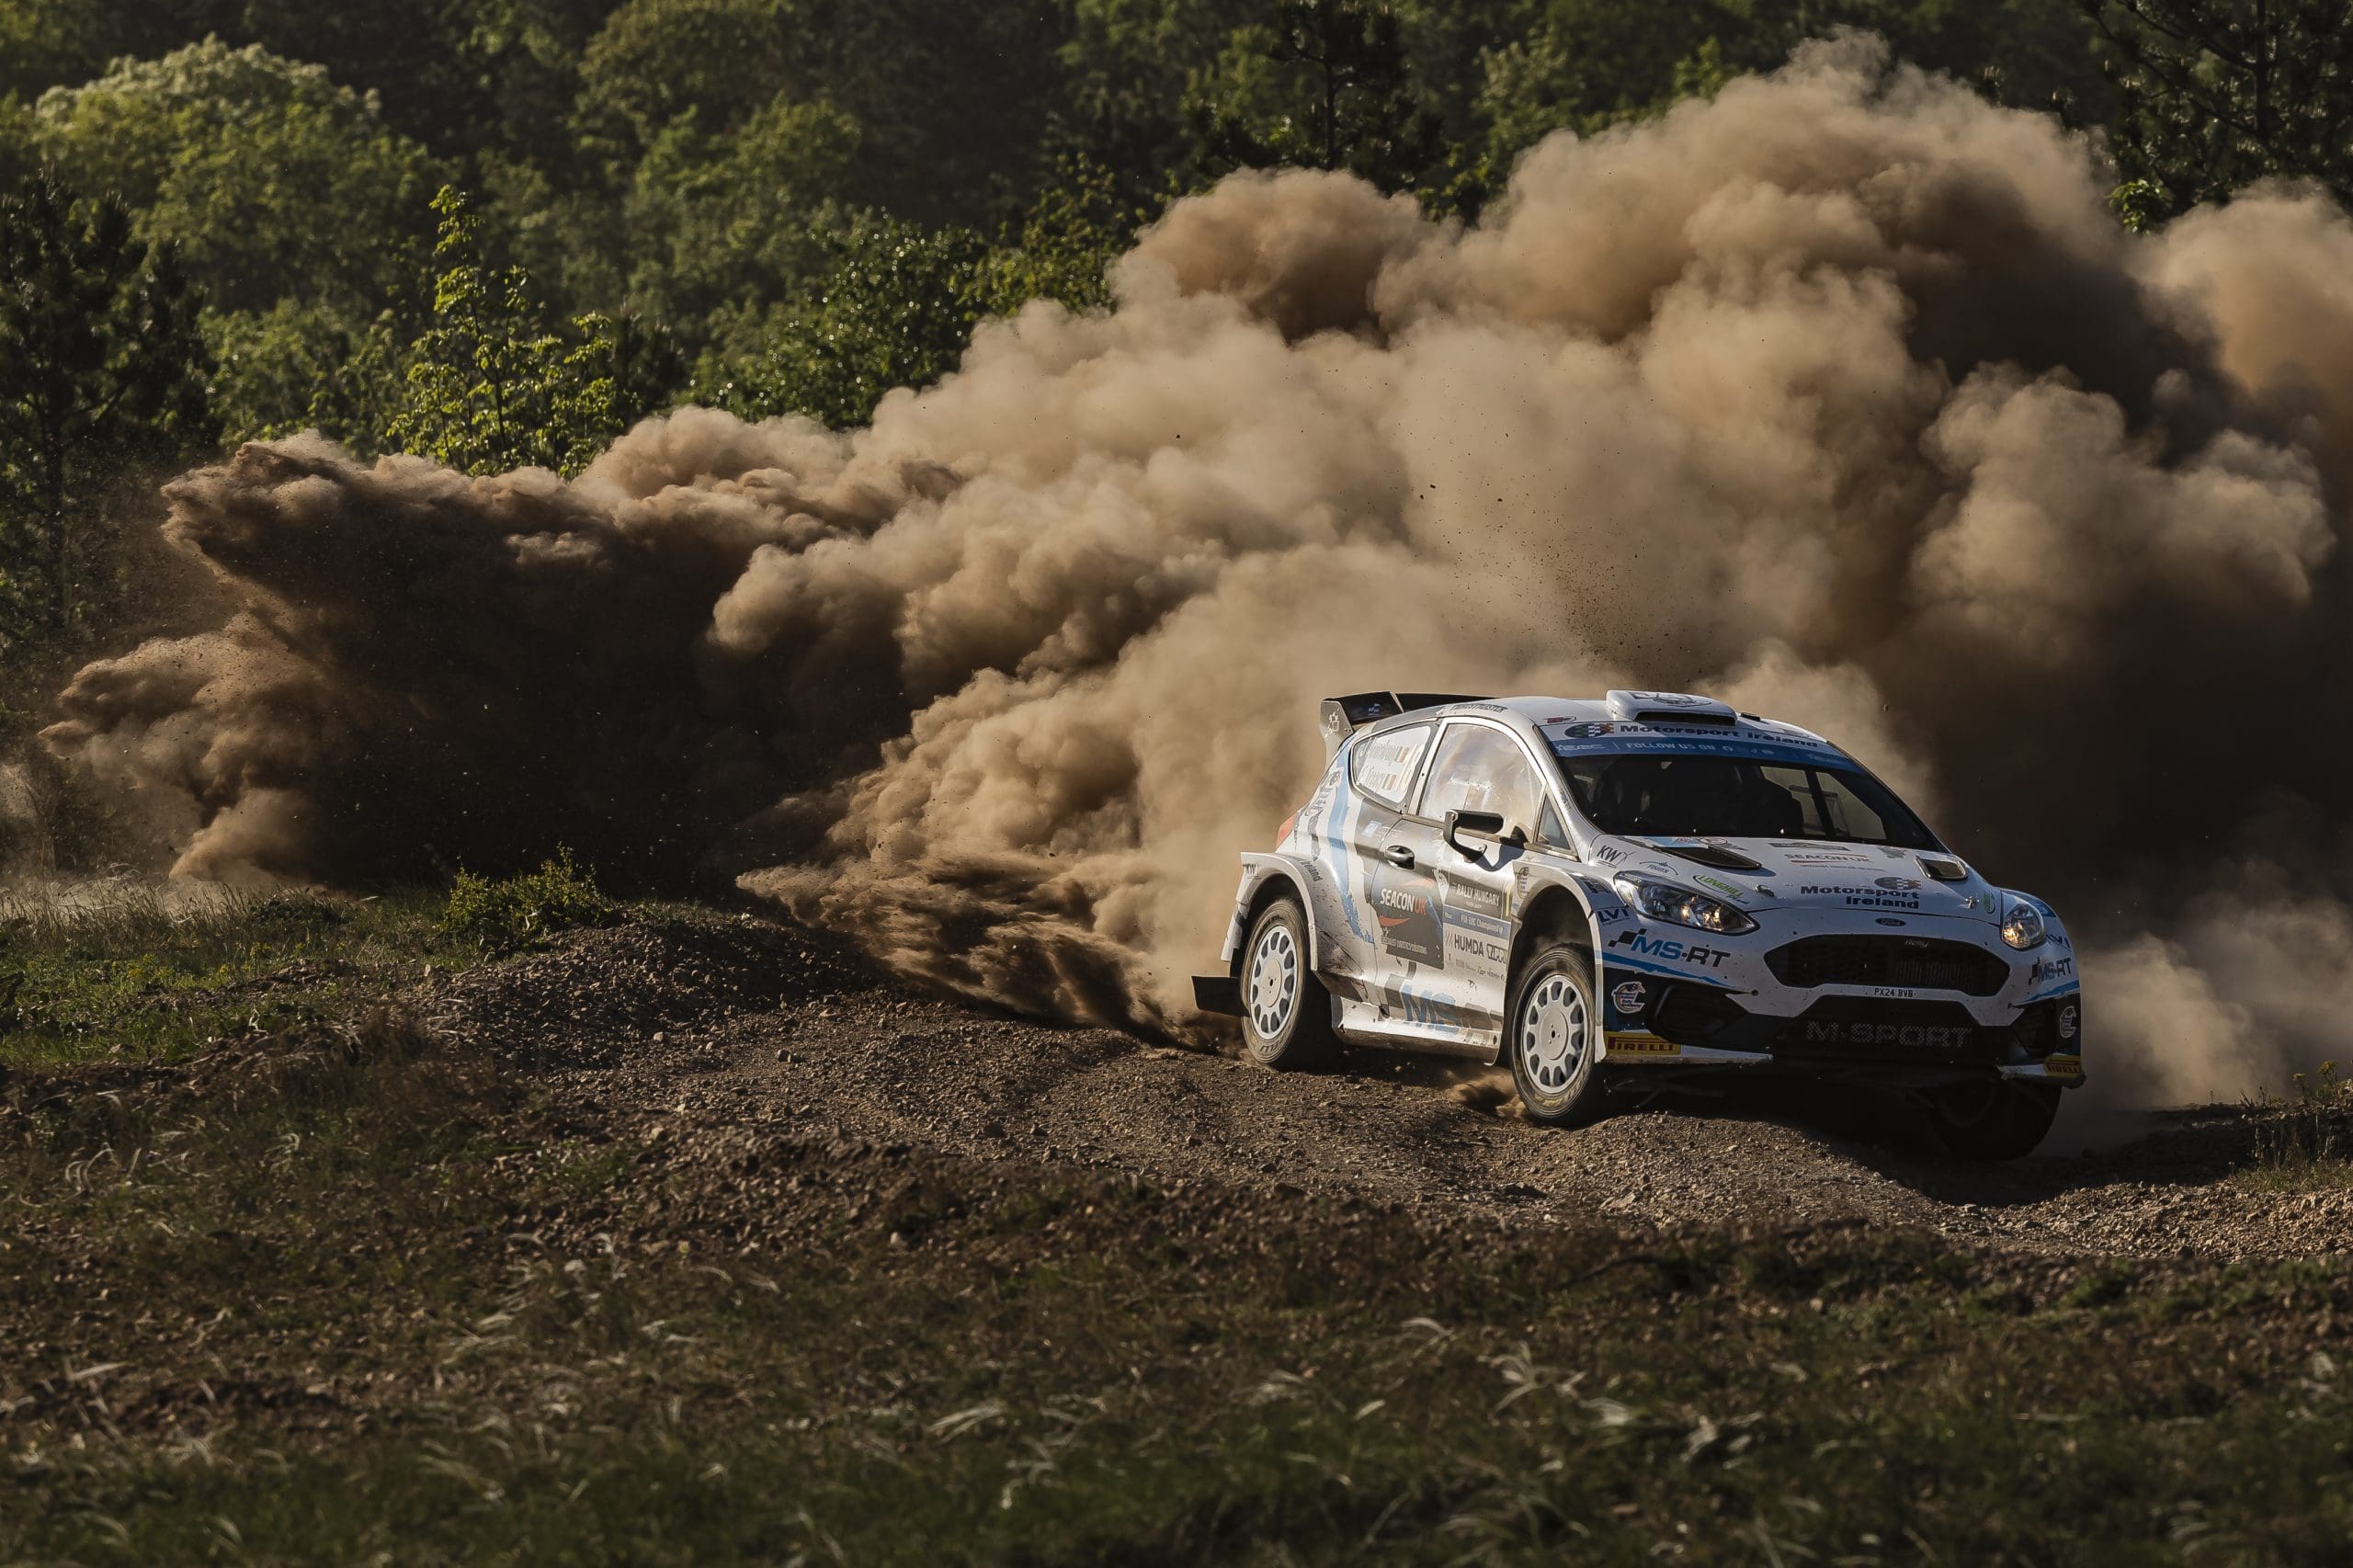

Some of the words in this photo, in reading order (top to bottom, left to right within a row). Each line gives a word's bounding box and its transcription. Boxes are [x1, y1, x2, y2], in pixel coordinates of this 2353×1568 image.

[1620, 724, 1740, 739] Motorsport
[1747, 732, 1818, 748] Ireland
[1626, 742, 1676, 750] FOLLOW
[1597, 845, 1623, 863] KW
[1381, 888, 1415, 913] SEACON
[1456, 883, 1474, 900] RALLY
[1474, 889, 1500, 908] HUNGARY
[1801, 885, 1920, 900] Motorsport
[1846, 895, 1919, 909] Ireland
[1454, 934, 1484, 957] HUMDA
[1874, 988, 1896, 997] PX24
[1897, 989, 1914, 998] BVB
[1608, 1036, 1674, 1051] PIRELLI
